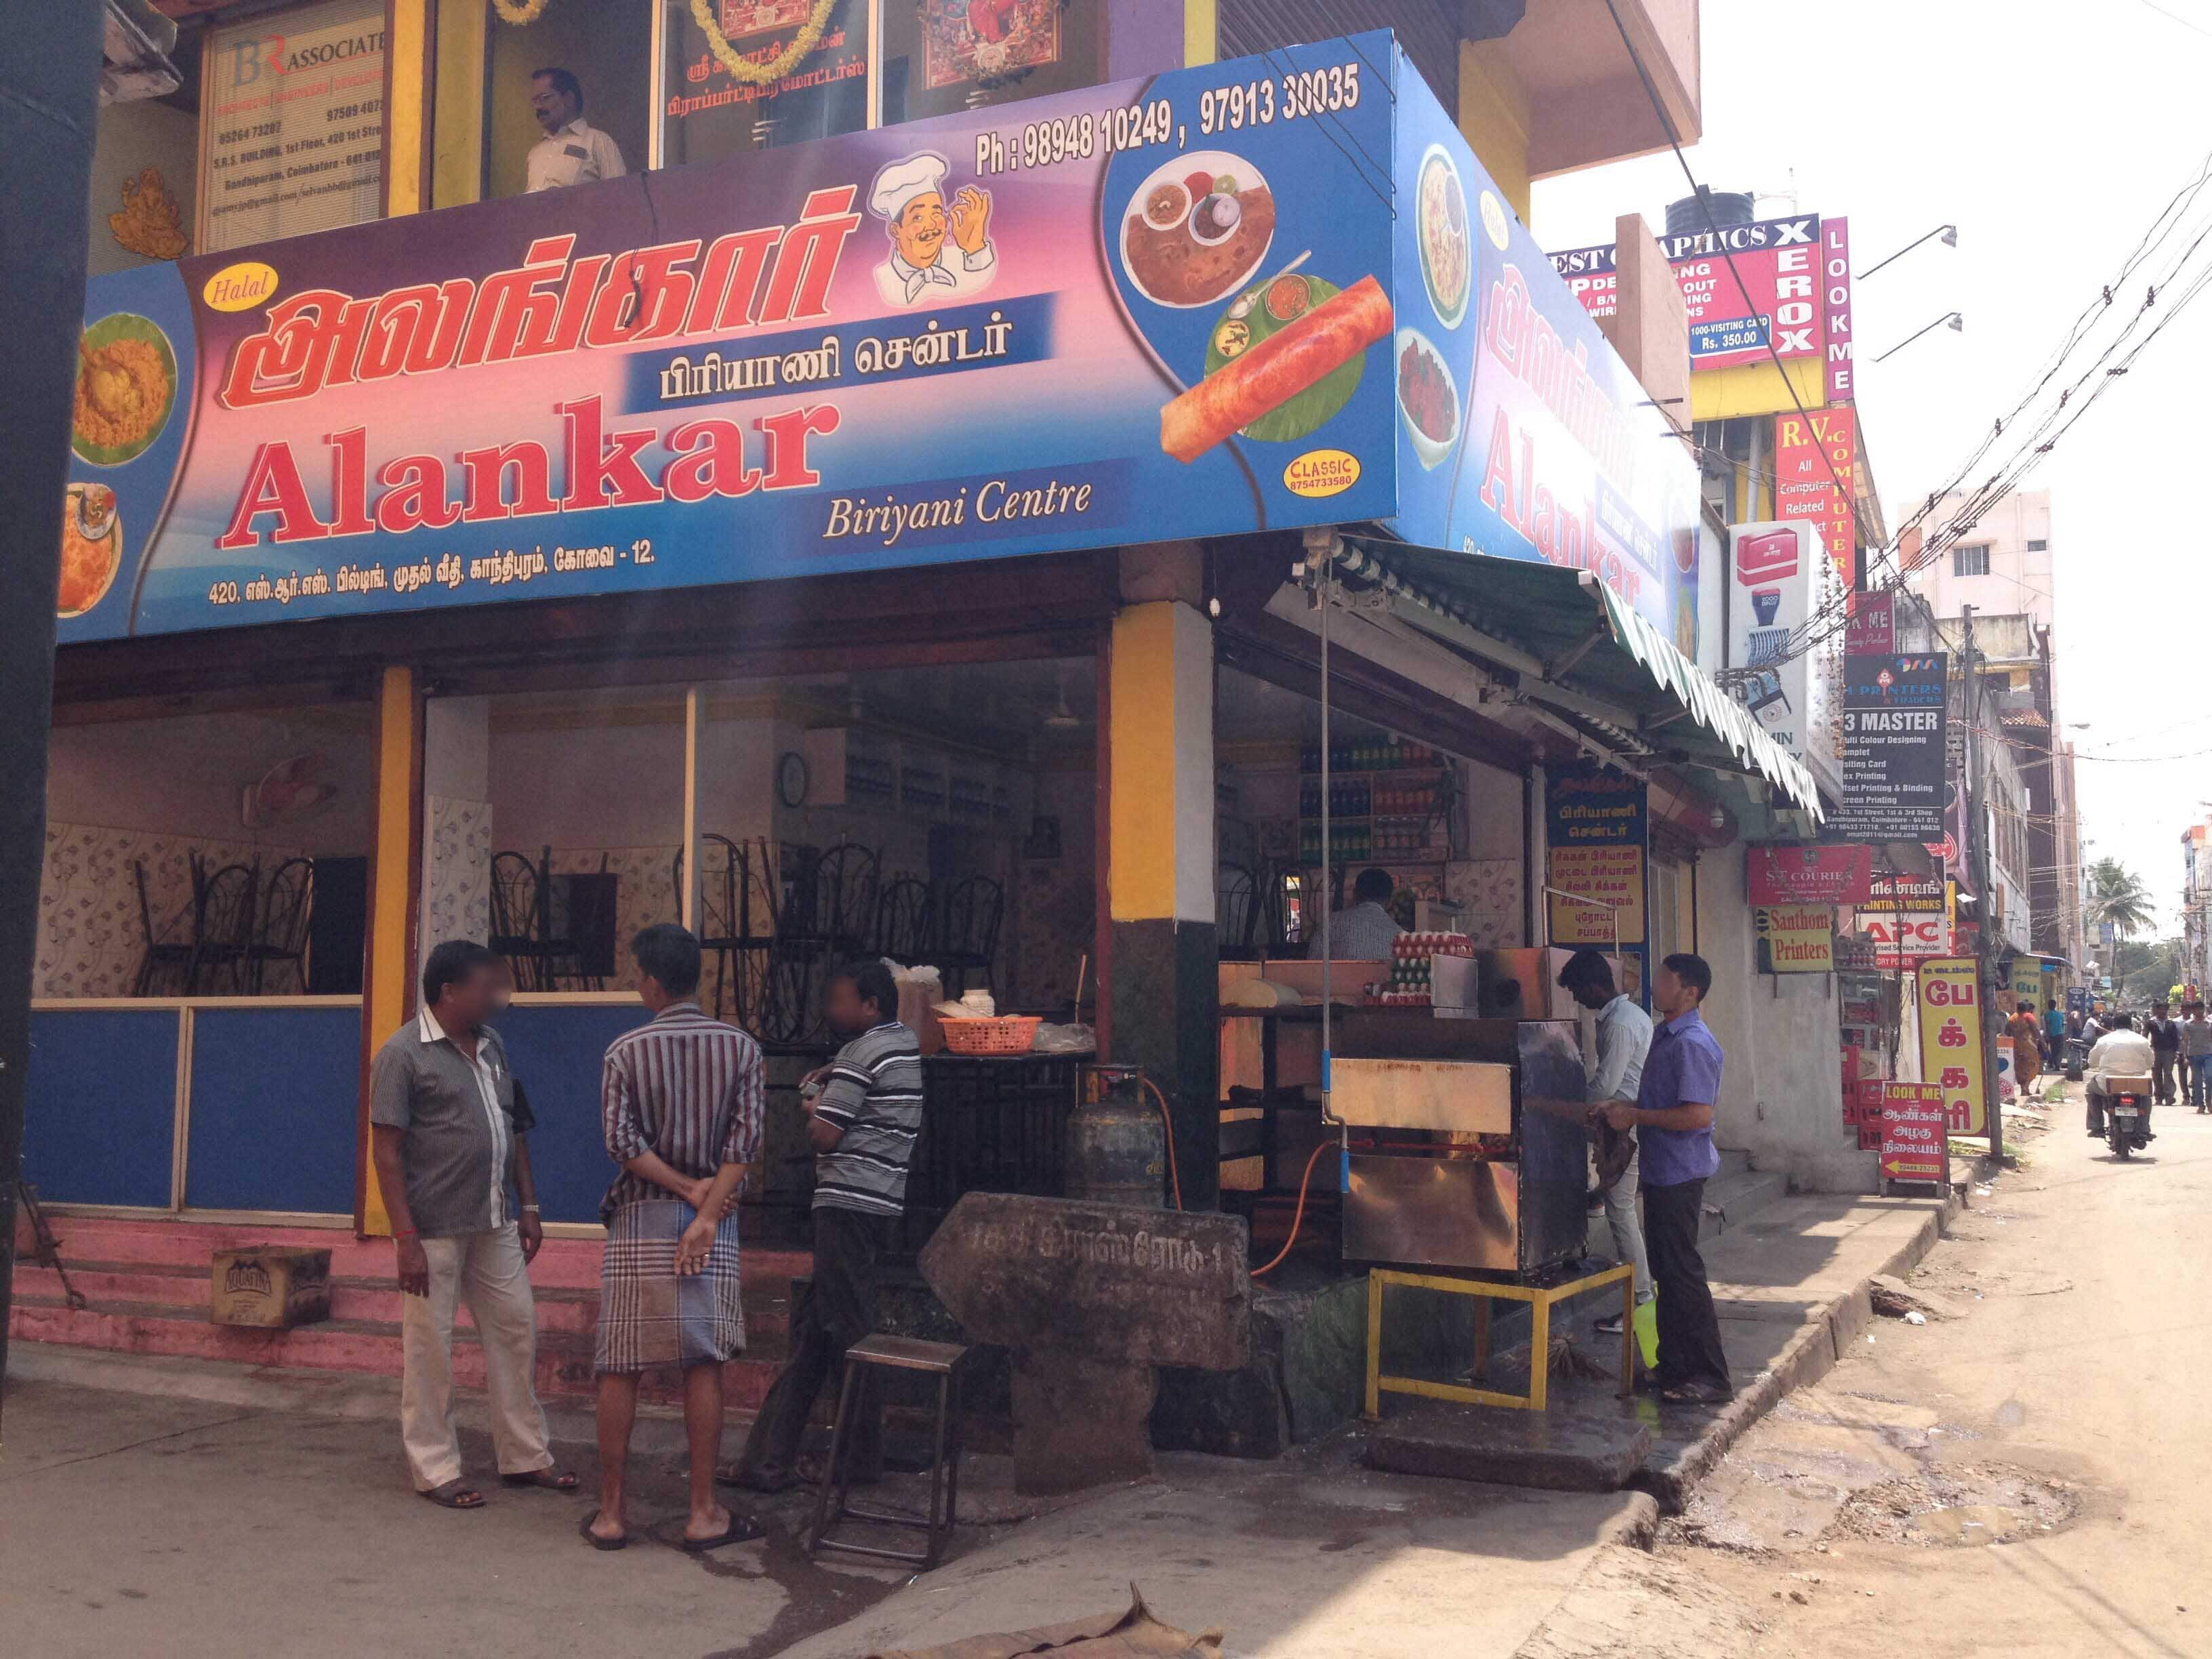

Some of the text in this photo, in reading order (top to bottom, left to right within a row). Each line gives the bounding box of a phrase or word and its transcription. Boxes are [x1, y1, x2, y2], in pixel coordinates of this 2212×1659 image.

[1023, 114, 1093, 168] 98948
[1100, 99, 1172, 152] 10249
[1200, 79, 1275, 135] 97913
[1282, 63, 1359, 120] 30035
[1549, 248, 1605, 275] EST
[211, 272, 268, 304] Halal
[217, 184, 861, 409] அலங்கார்
[1774, 220, 1814, 354] XEROX
[1702, 331, 1757, 350] Rs. 350.00
[659, 311, 1012, 400] பிரியாணி சென்டர்
[216, 393, 841, 550] Alankar
[1290, 458, 1351, 478] CLASSIC
[1798, 459, 1812, 472] All
[1290, 475, 1351, 490] 8754733580
[1780, 480, 1830, 495] Computer
[823, 480, 1092, 546] Biriyani Centre
[1785, 499, 1825, 515] Related
[393, 555, 432, 592] முதல்
[553, 545, 615, 571] கோவை
[1861, 712, 1938, 731] MASTER
[1860, 736, 1885, 744] Colour
[1887, 735, 1927, 745] Designing
[1868, 760, 1887, 768] Card
[1856, 772, 1887, 781] Printing
[1861, 784, 1891, 793] Printing
[1903, 783, 1933, 793] Binding
[1866, 796, 1898, 805] Printing
[1906, 899, 1942, 910] WORKS
[1771, 908, 1830, 931] Santhom
[1866, 921, 1940, 943] APC
[1775, 938, 1829, 960] Printers
[1886, 1086, 1941, 1100] LOOK ME
[1883, 1107, 1943, 1122] ஆண்கள்
